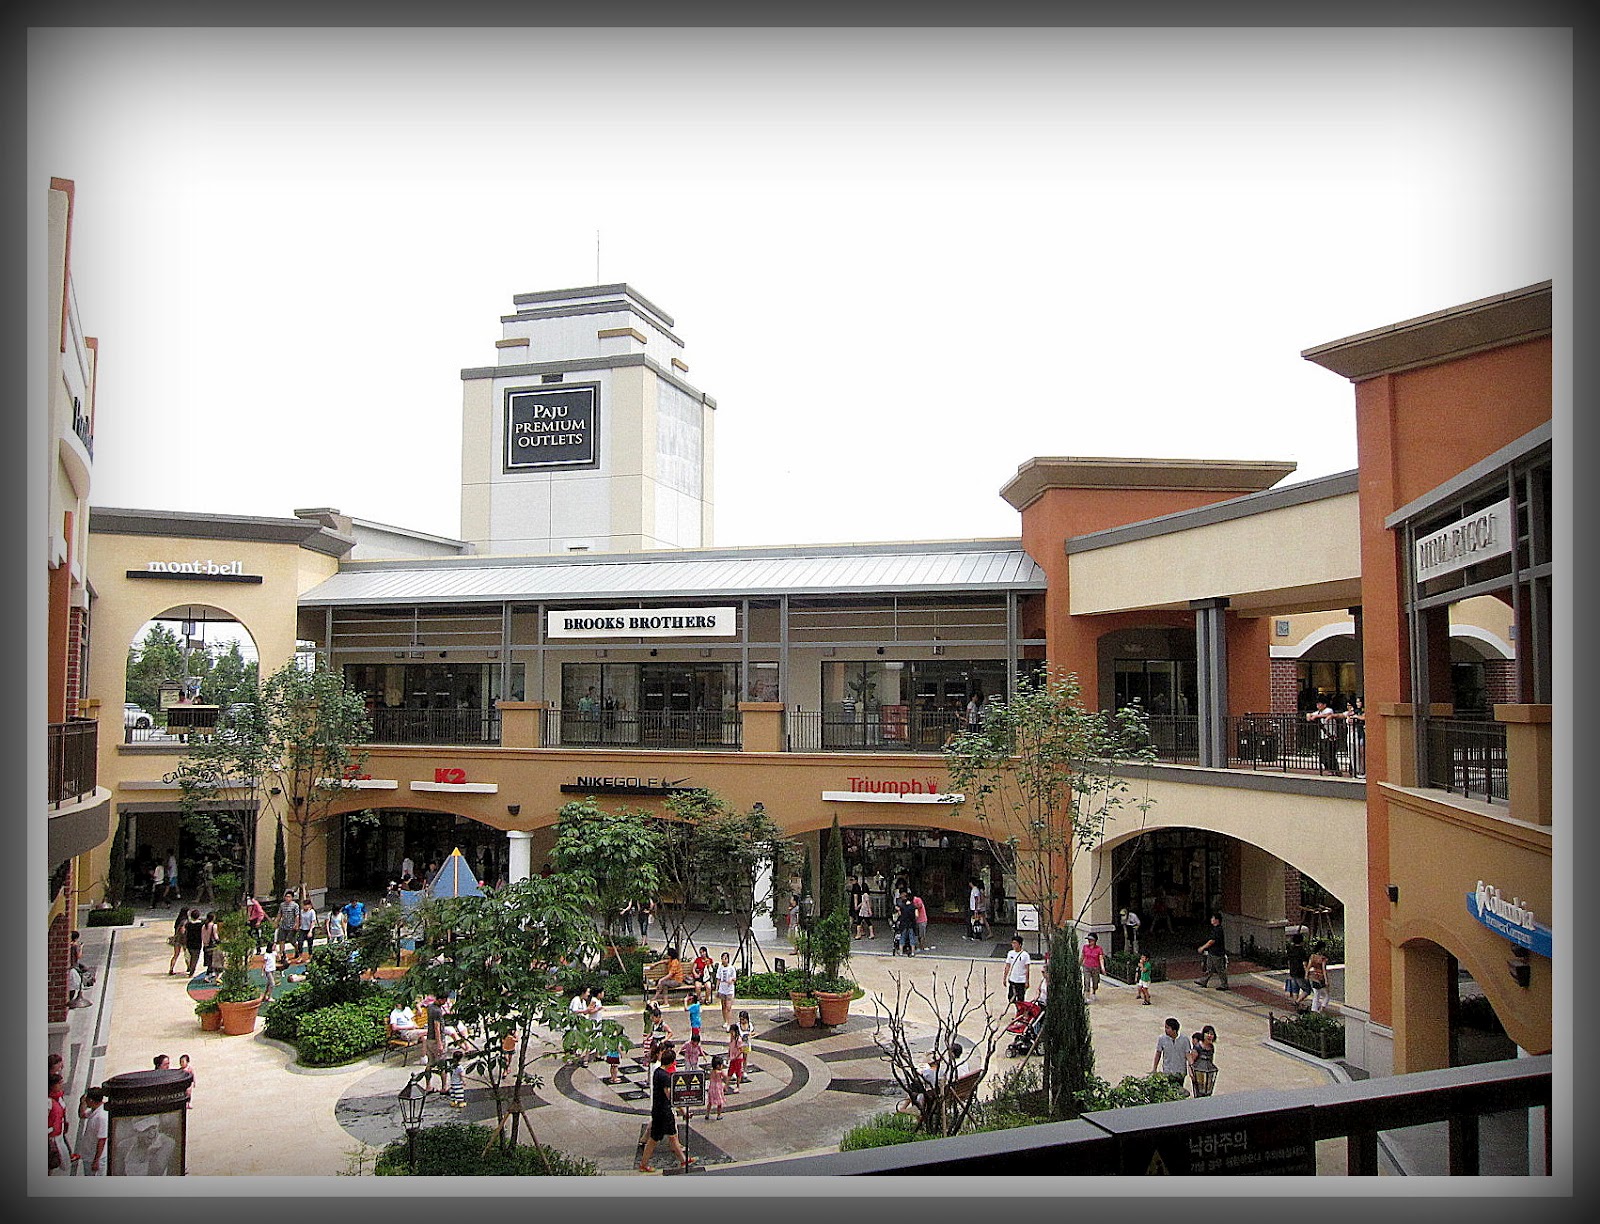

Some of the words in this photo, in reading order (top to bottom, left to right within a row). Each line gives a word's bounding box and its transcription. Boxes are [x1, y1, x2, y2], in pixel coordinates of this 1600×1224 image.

[515, 419, 586, 434] PREMIUM
[518, 433, 583, 448] OUTLETS
[563, 617, 625, 630] BROOKS
[628, 615, 717, 630] BROTHERS
[434, 767, 467, 784] K2
[847, 776, 923, 799] Triumph
[1484, 884, 1537, 931] Columbia
[1188, 1129, 1248, 1157] 낙하주의
